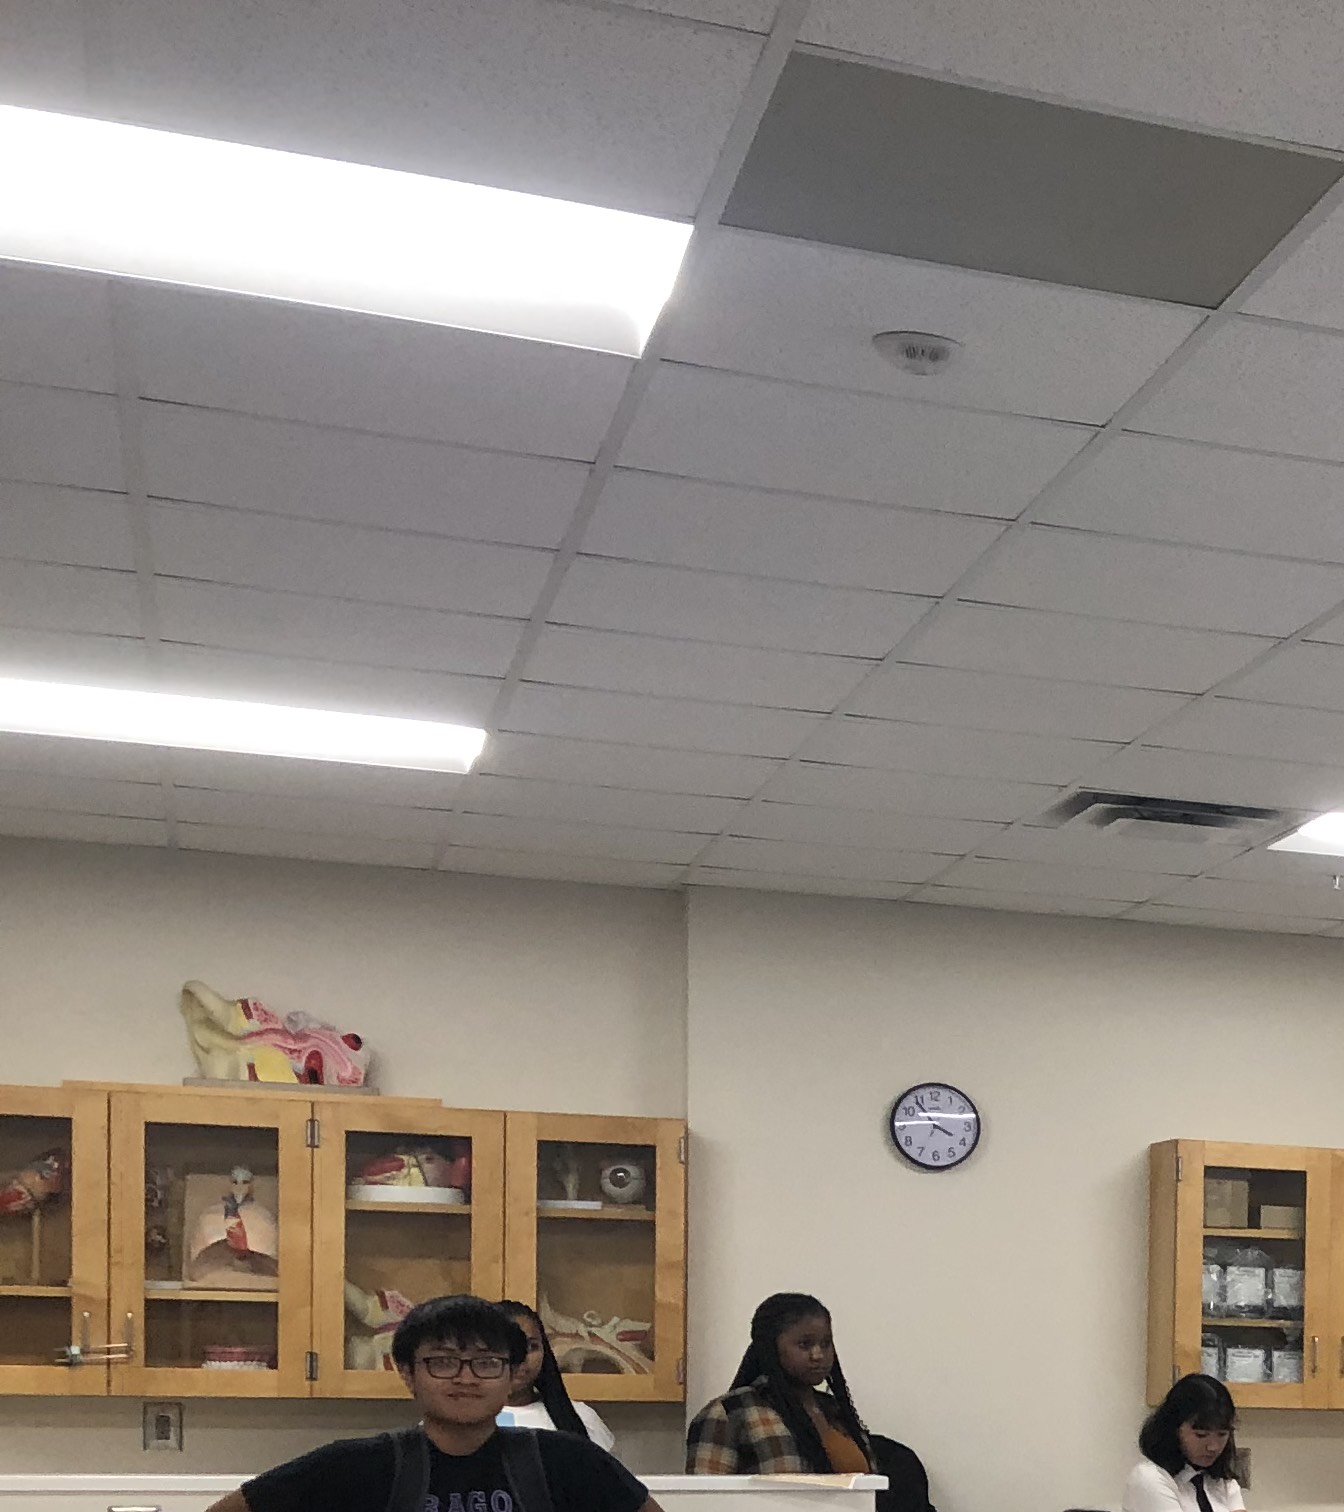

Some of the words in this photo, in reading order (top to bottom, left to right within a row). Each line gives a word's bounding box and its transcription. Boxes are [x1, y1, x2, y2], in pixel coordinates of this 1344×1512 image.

[930, 1091, 940, 1101] 12
[948, 1096, 953, 1105] 1
[903, 1106, 915, 1116] 10
[964, 1121, 971, 1132] 3
[904, 1136, 912, 1146] 8
[959, 1136, 966, 1146] 4
[917, 1146, 925, 1157] 7
[932, 1150, 940, 1162] 6
[948, 1147, 955, 1158] 5
